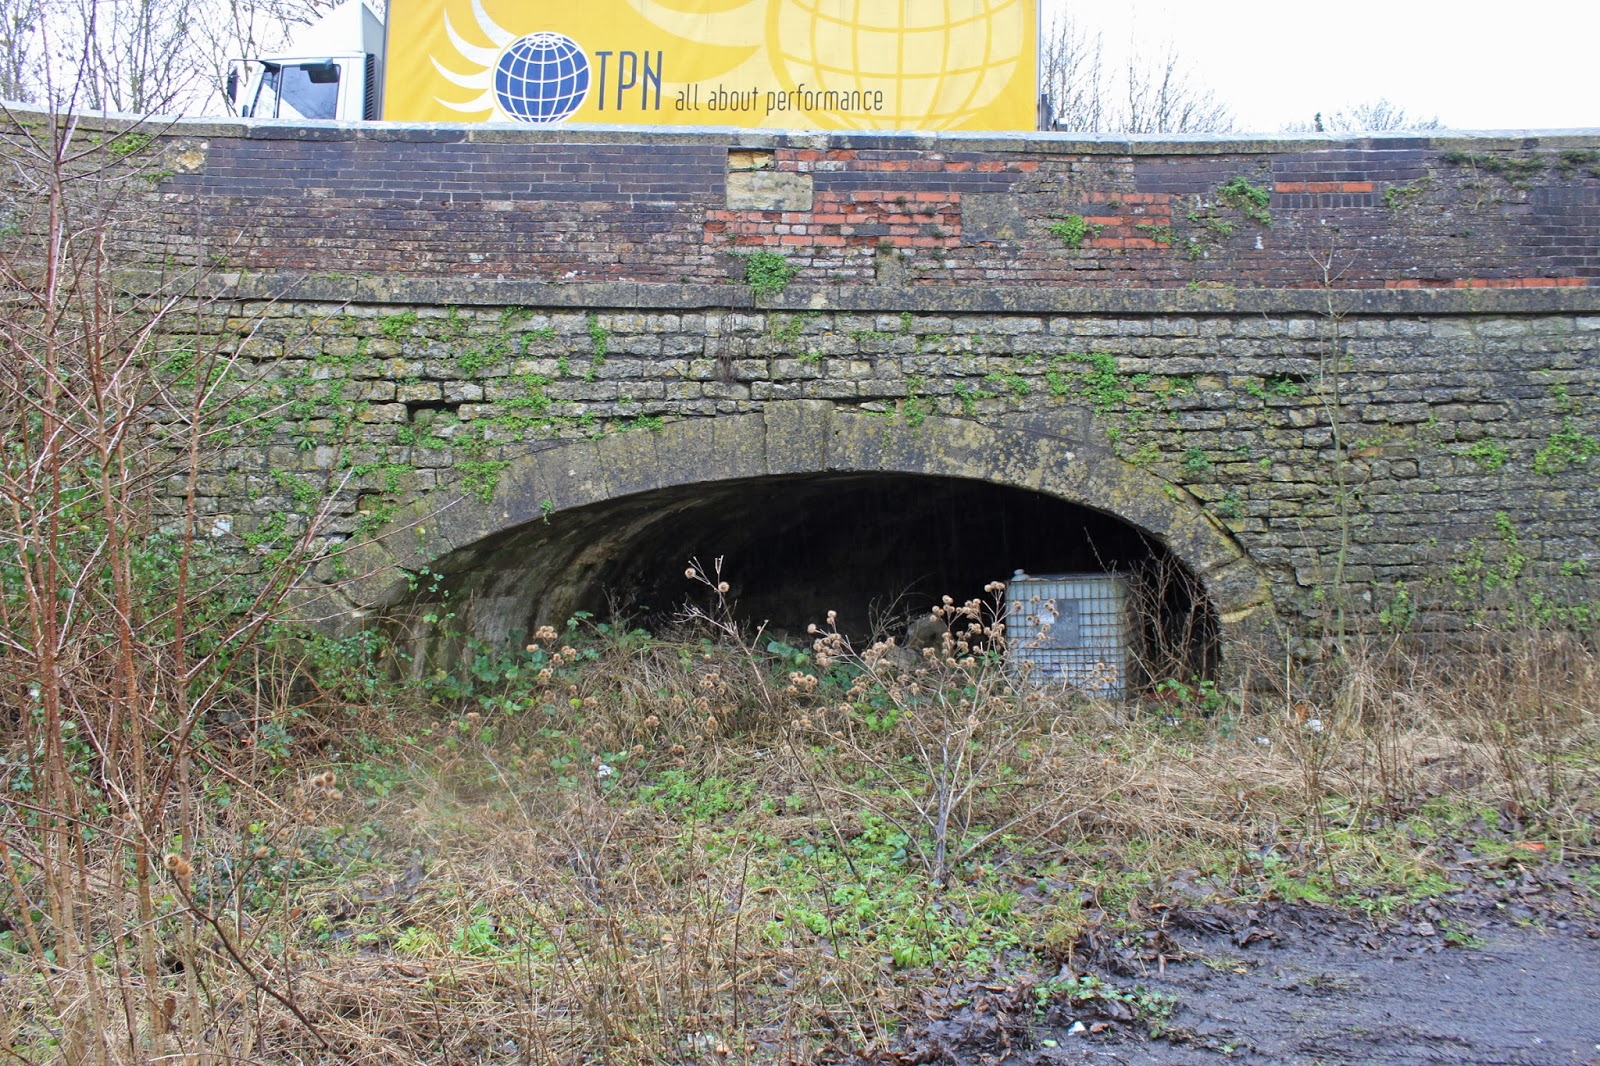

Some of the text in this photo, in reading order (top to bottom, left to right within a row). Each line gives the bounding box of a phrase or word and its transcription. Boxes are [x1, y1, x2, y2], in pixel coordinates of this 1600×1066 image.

[595, 50, 663, 111] TPN
[675, 83, 883, 116] all about performance
